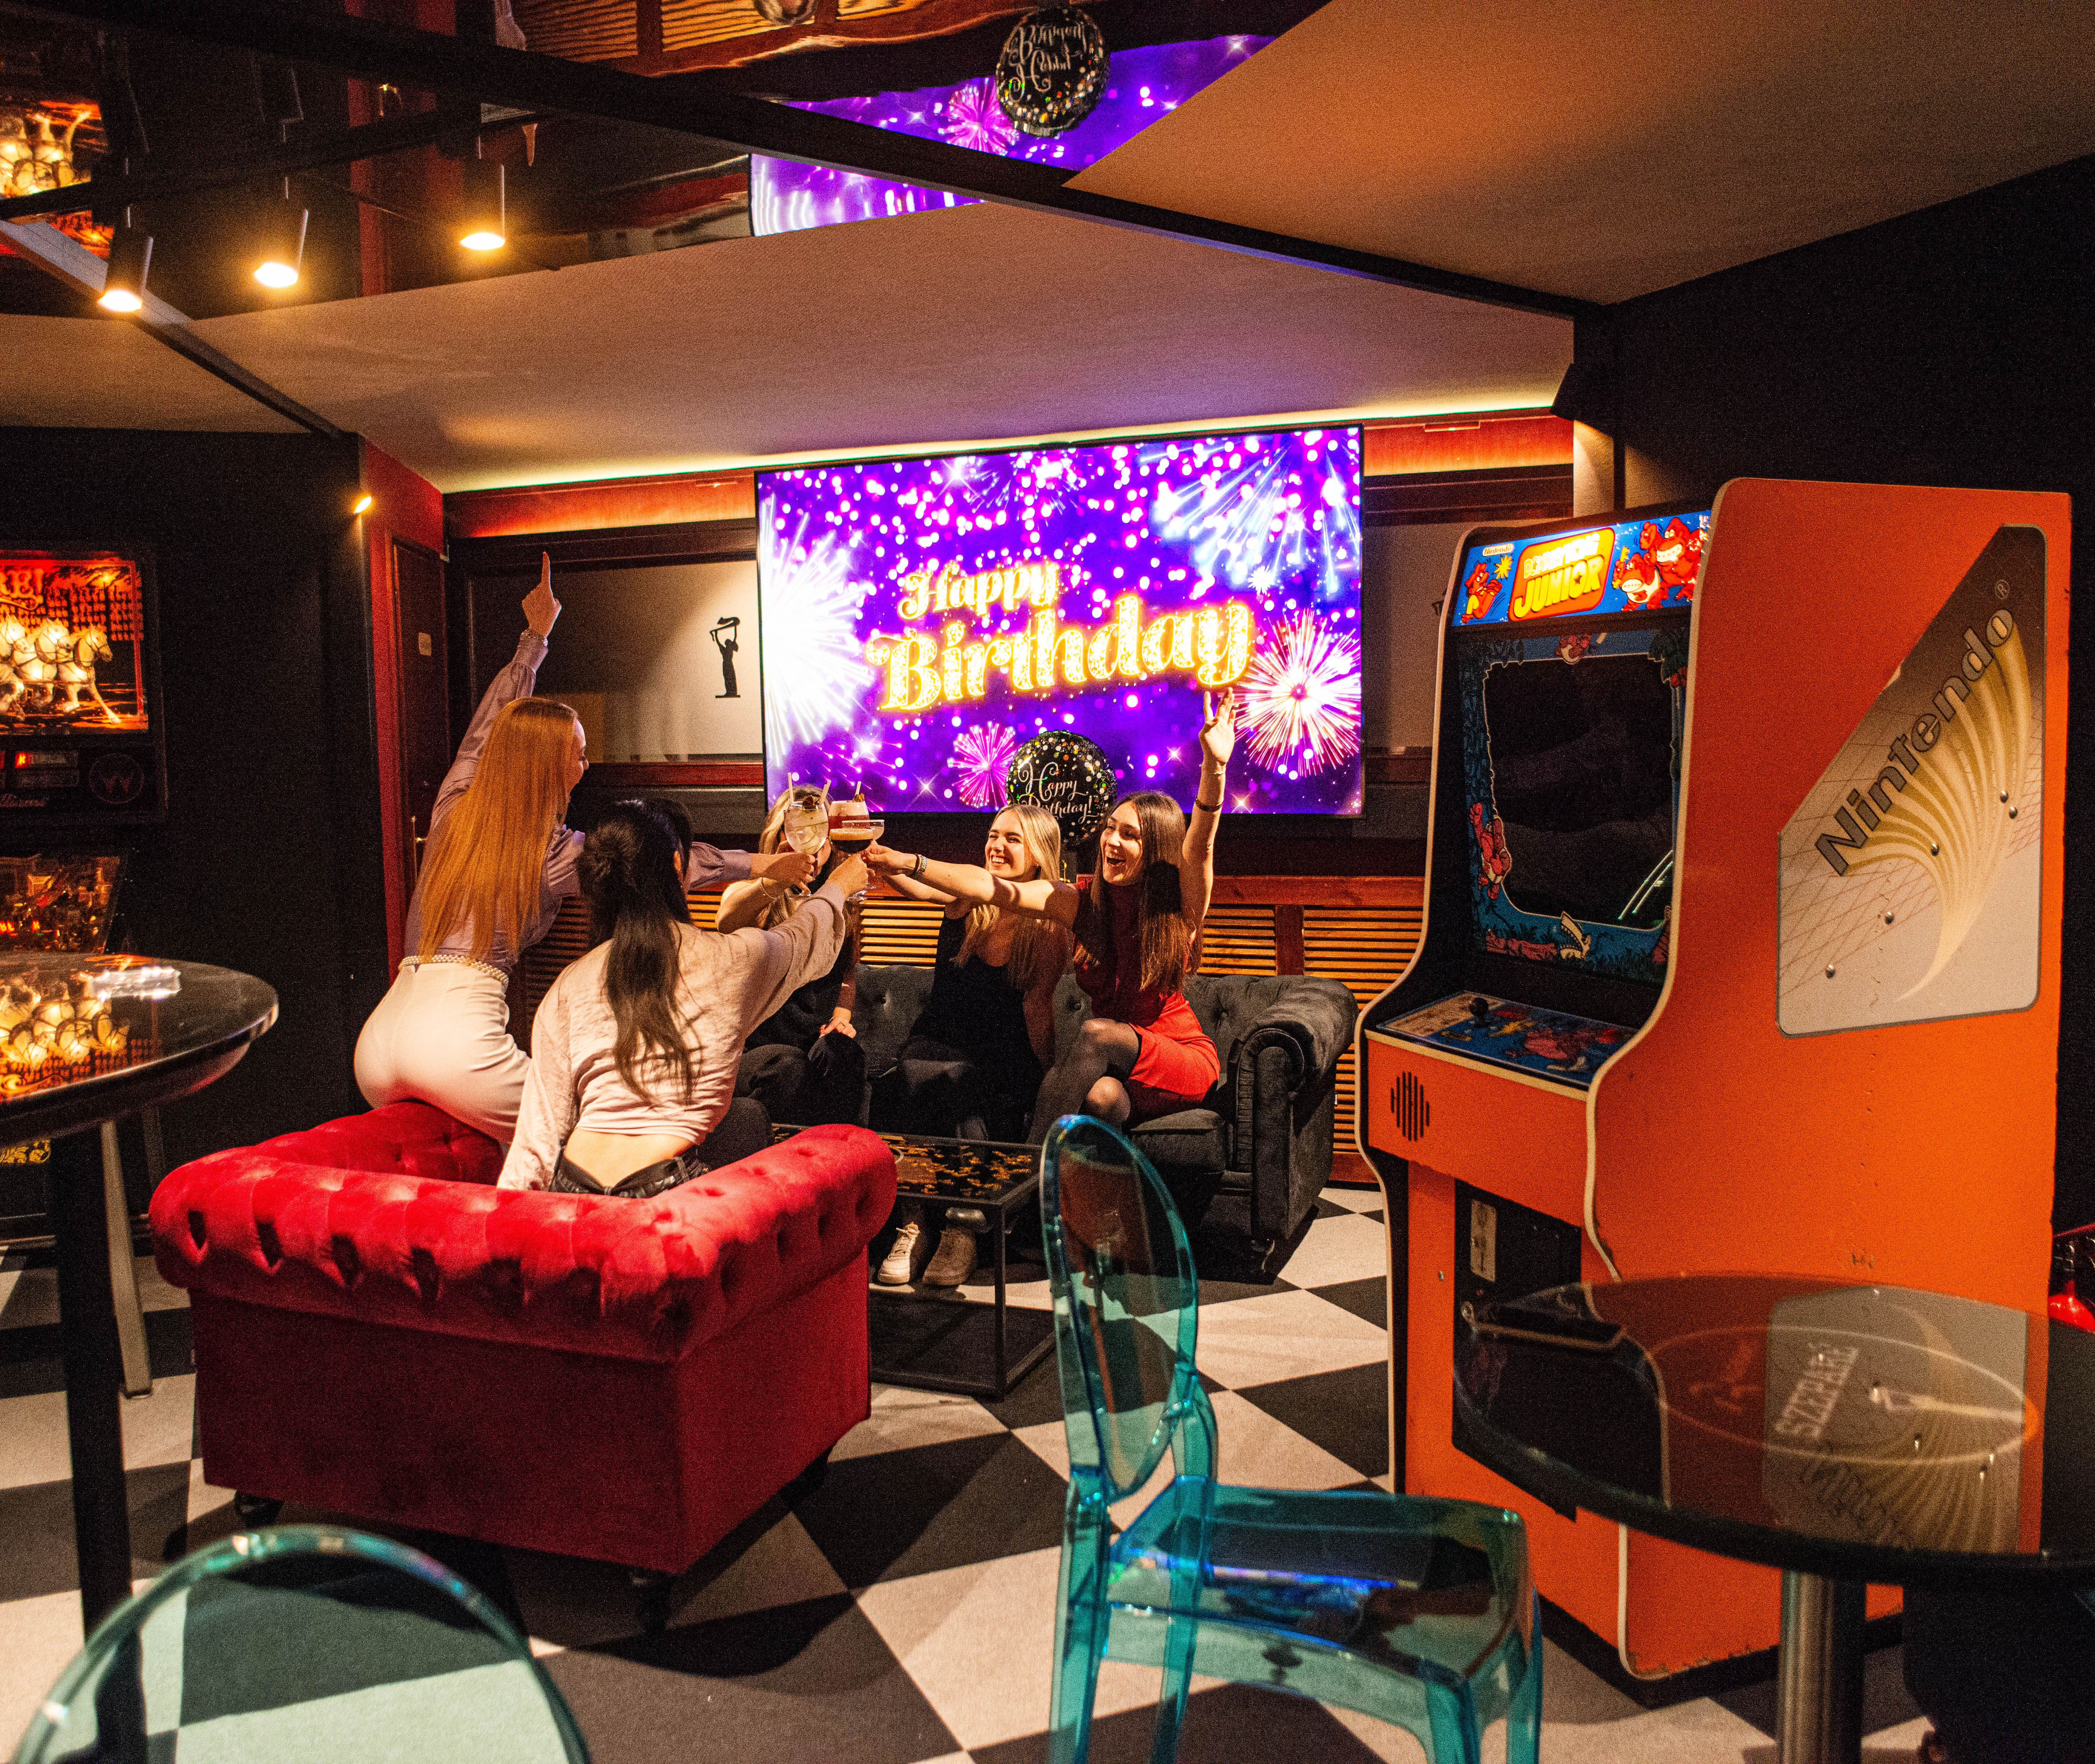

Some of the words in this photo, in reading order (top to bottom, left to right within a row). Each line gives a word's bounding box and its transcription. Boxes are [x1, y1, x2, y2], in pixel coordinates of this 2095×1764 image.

[1484, 545, 1511, 555] Nintendo
[897, 560, 1060, 621] Happy
[1513, 556, 1604, 618] JUNIOR
[865, 596, 1250, 711] Birthday
[1815, 609, 2015, 877] Nintendo
[1018, 761, 1089, 802] Happy
[1018, 793, 1098, 825] rthday!
